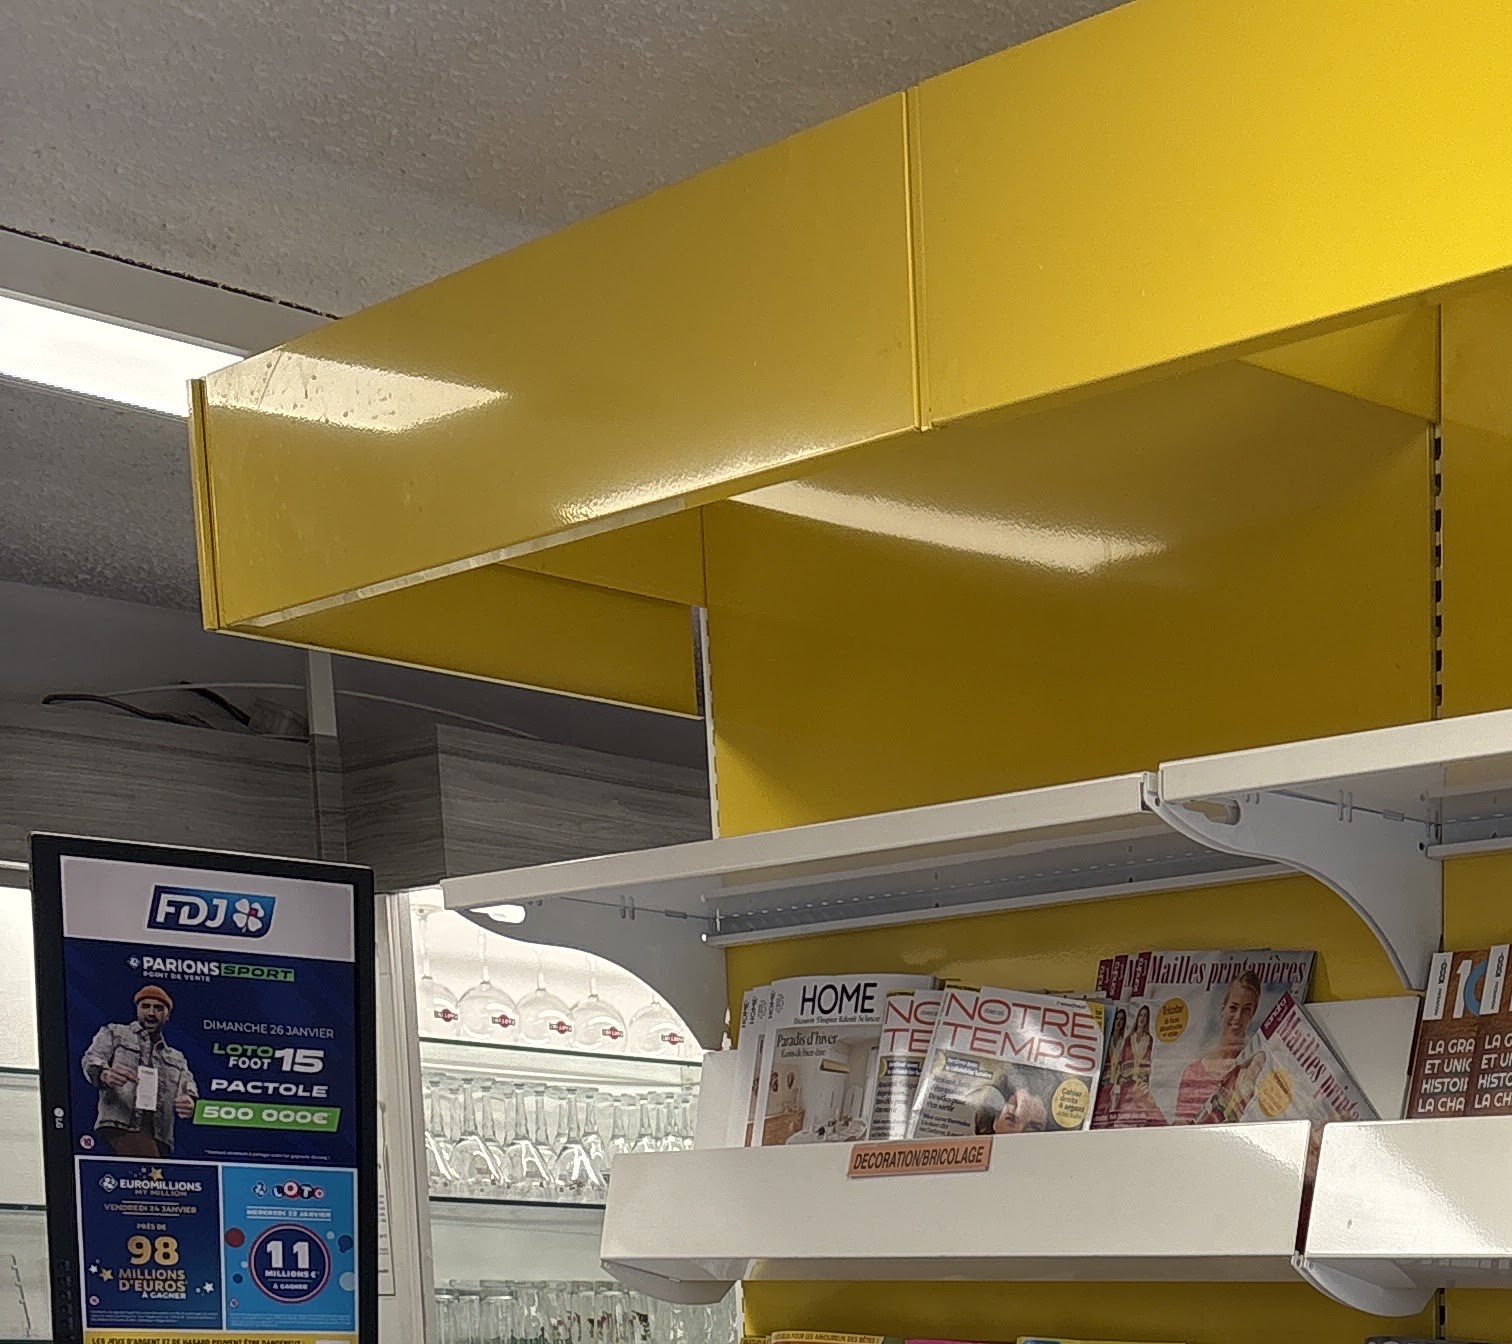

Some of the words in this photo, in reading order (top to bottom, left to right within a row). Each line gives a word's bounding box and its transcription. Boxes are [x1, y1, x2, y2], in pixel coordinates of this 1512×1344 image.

[156, 893, 228, 928] FDJ
[143, 956, 220, 976] PARIONS
[222, 965, 293, 980] SPORT
[1149, 954, 1207, 991] Mailles
[1206, 955, 1309, 992] printanières
[800, 982, 879, 1016] HOME
[944, 990, 1097, 1041] NOTRE
[203, 1019, 268, 1034] DIMANCHE
[270, 1024, 284, 1035] 26
[286, 1026, 334, 1039] JANVIER
[947, 1021, 1097, 1073] TEMPS
[1484, 1033, 1499, 1050] LA
[213, 1043, 273, 1057] LOTO
[274, 1048, 324, 1074] 15
[229, 1057, 272, 1070] FOOT
[1481, 1052, 1496, 1068] ET
[211, 1079, 328, 1097] PACTOLE
[1474, 1093, 1489, 1109] LA
[853, 1144, 986, 1172] DECORATION/BRICOLAGE
[120, 1179, 202, 1191] EUROMILLIONS
[127, 1236, 179, 1266] 98
[119, 1269, 185, 1280] MILLIONS
